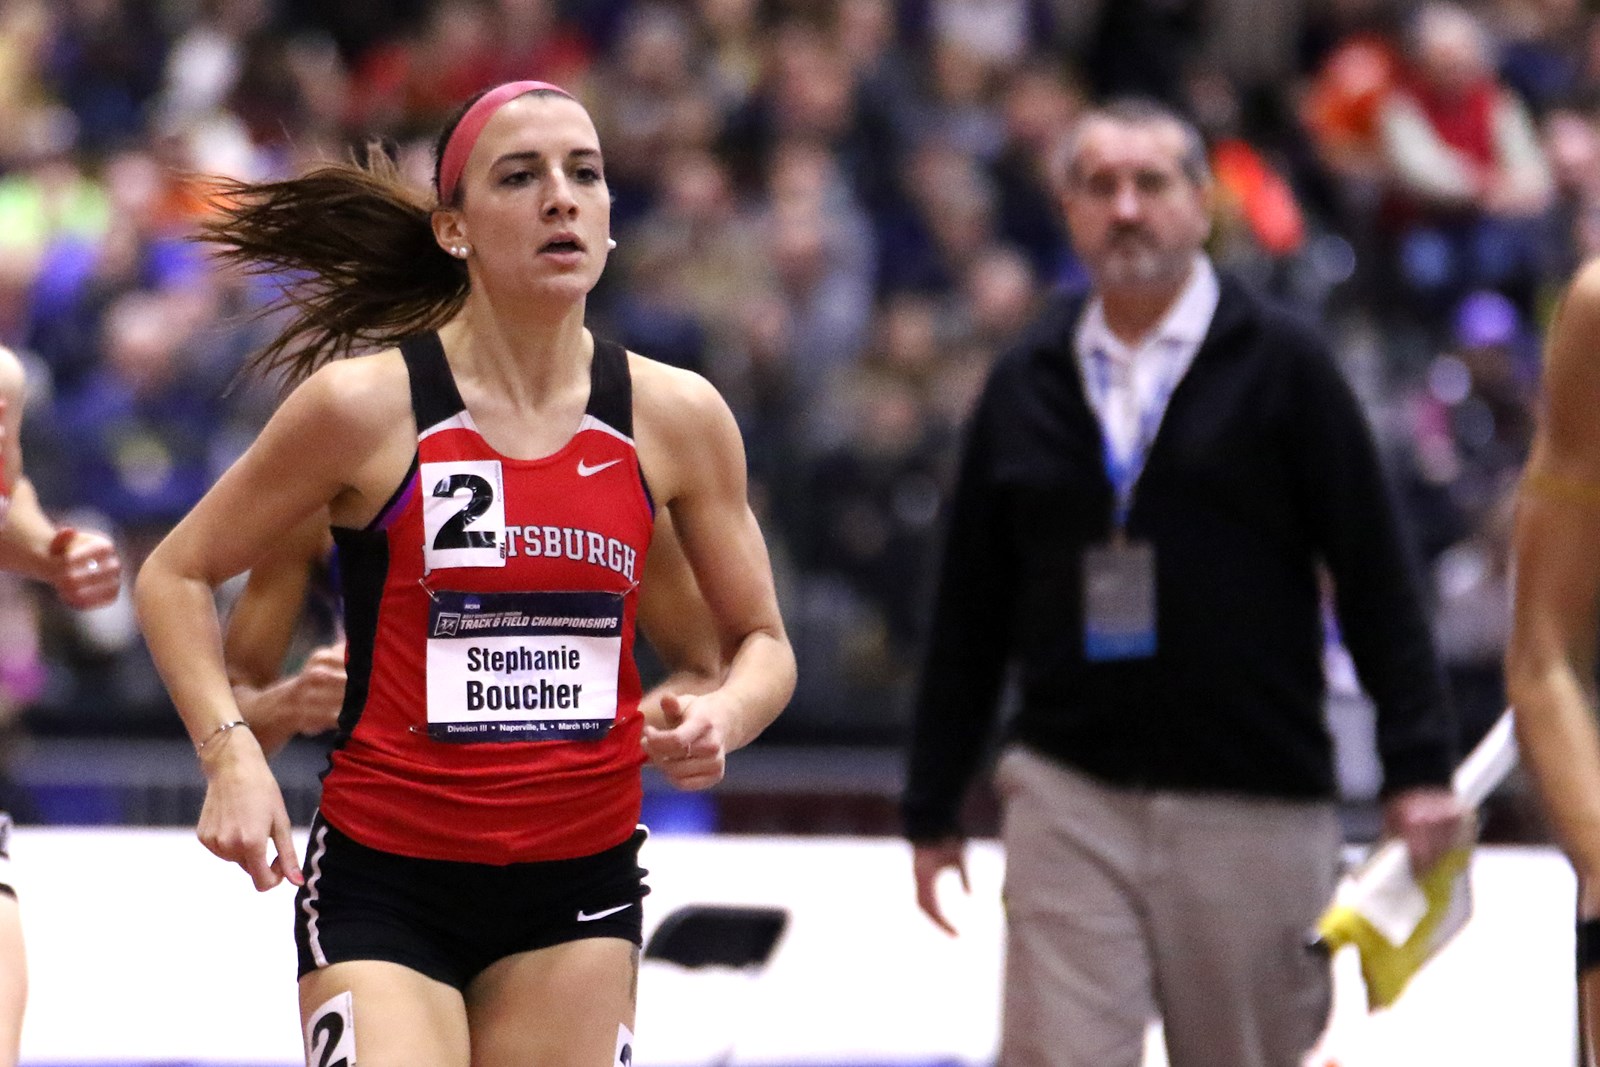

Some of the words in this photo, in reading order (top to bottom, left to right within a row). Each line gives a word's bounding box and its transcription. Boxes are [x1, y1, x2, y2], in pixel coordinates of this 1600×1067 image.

[432, 474, 497, 550] 2
[422, 525, 636, 582] TSBURGH
[460, 618, 493, 630] TRACK
[492, 617, 501, 627] &
[501, 616, 530, 627] FIELD
[531, 616, 618, 629] CHAMPIONSHIPS
[467, 646, 580, 674] Stephanie
[466, 679, 582, 711] Boucher
[480, 724, 488, 732] III
[500, 723, 539, 732] Naperville,
[558, 722, 580, 730] March
[582, 722, 599, 730] 10-11
[311, 1011, 348, 1067] 2
